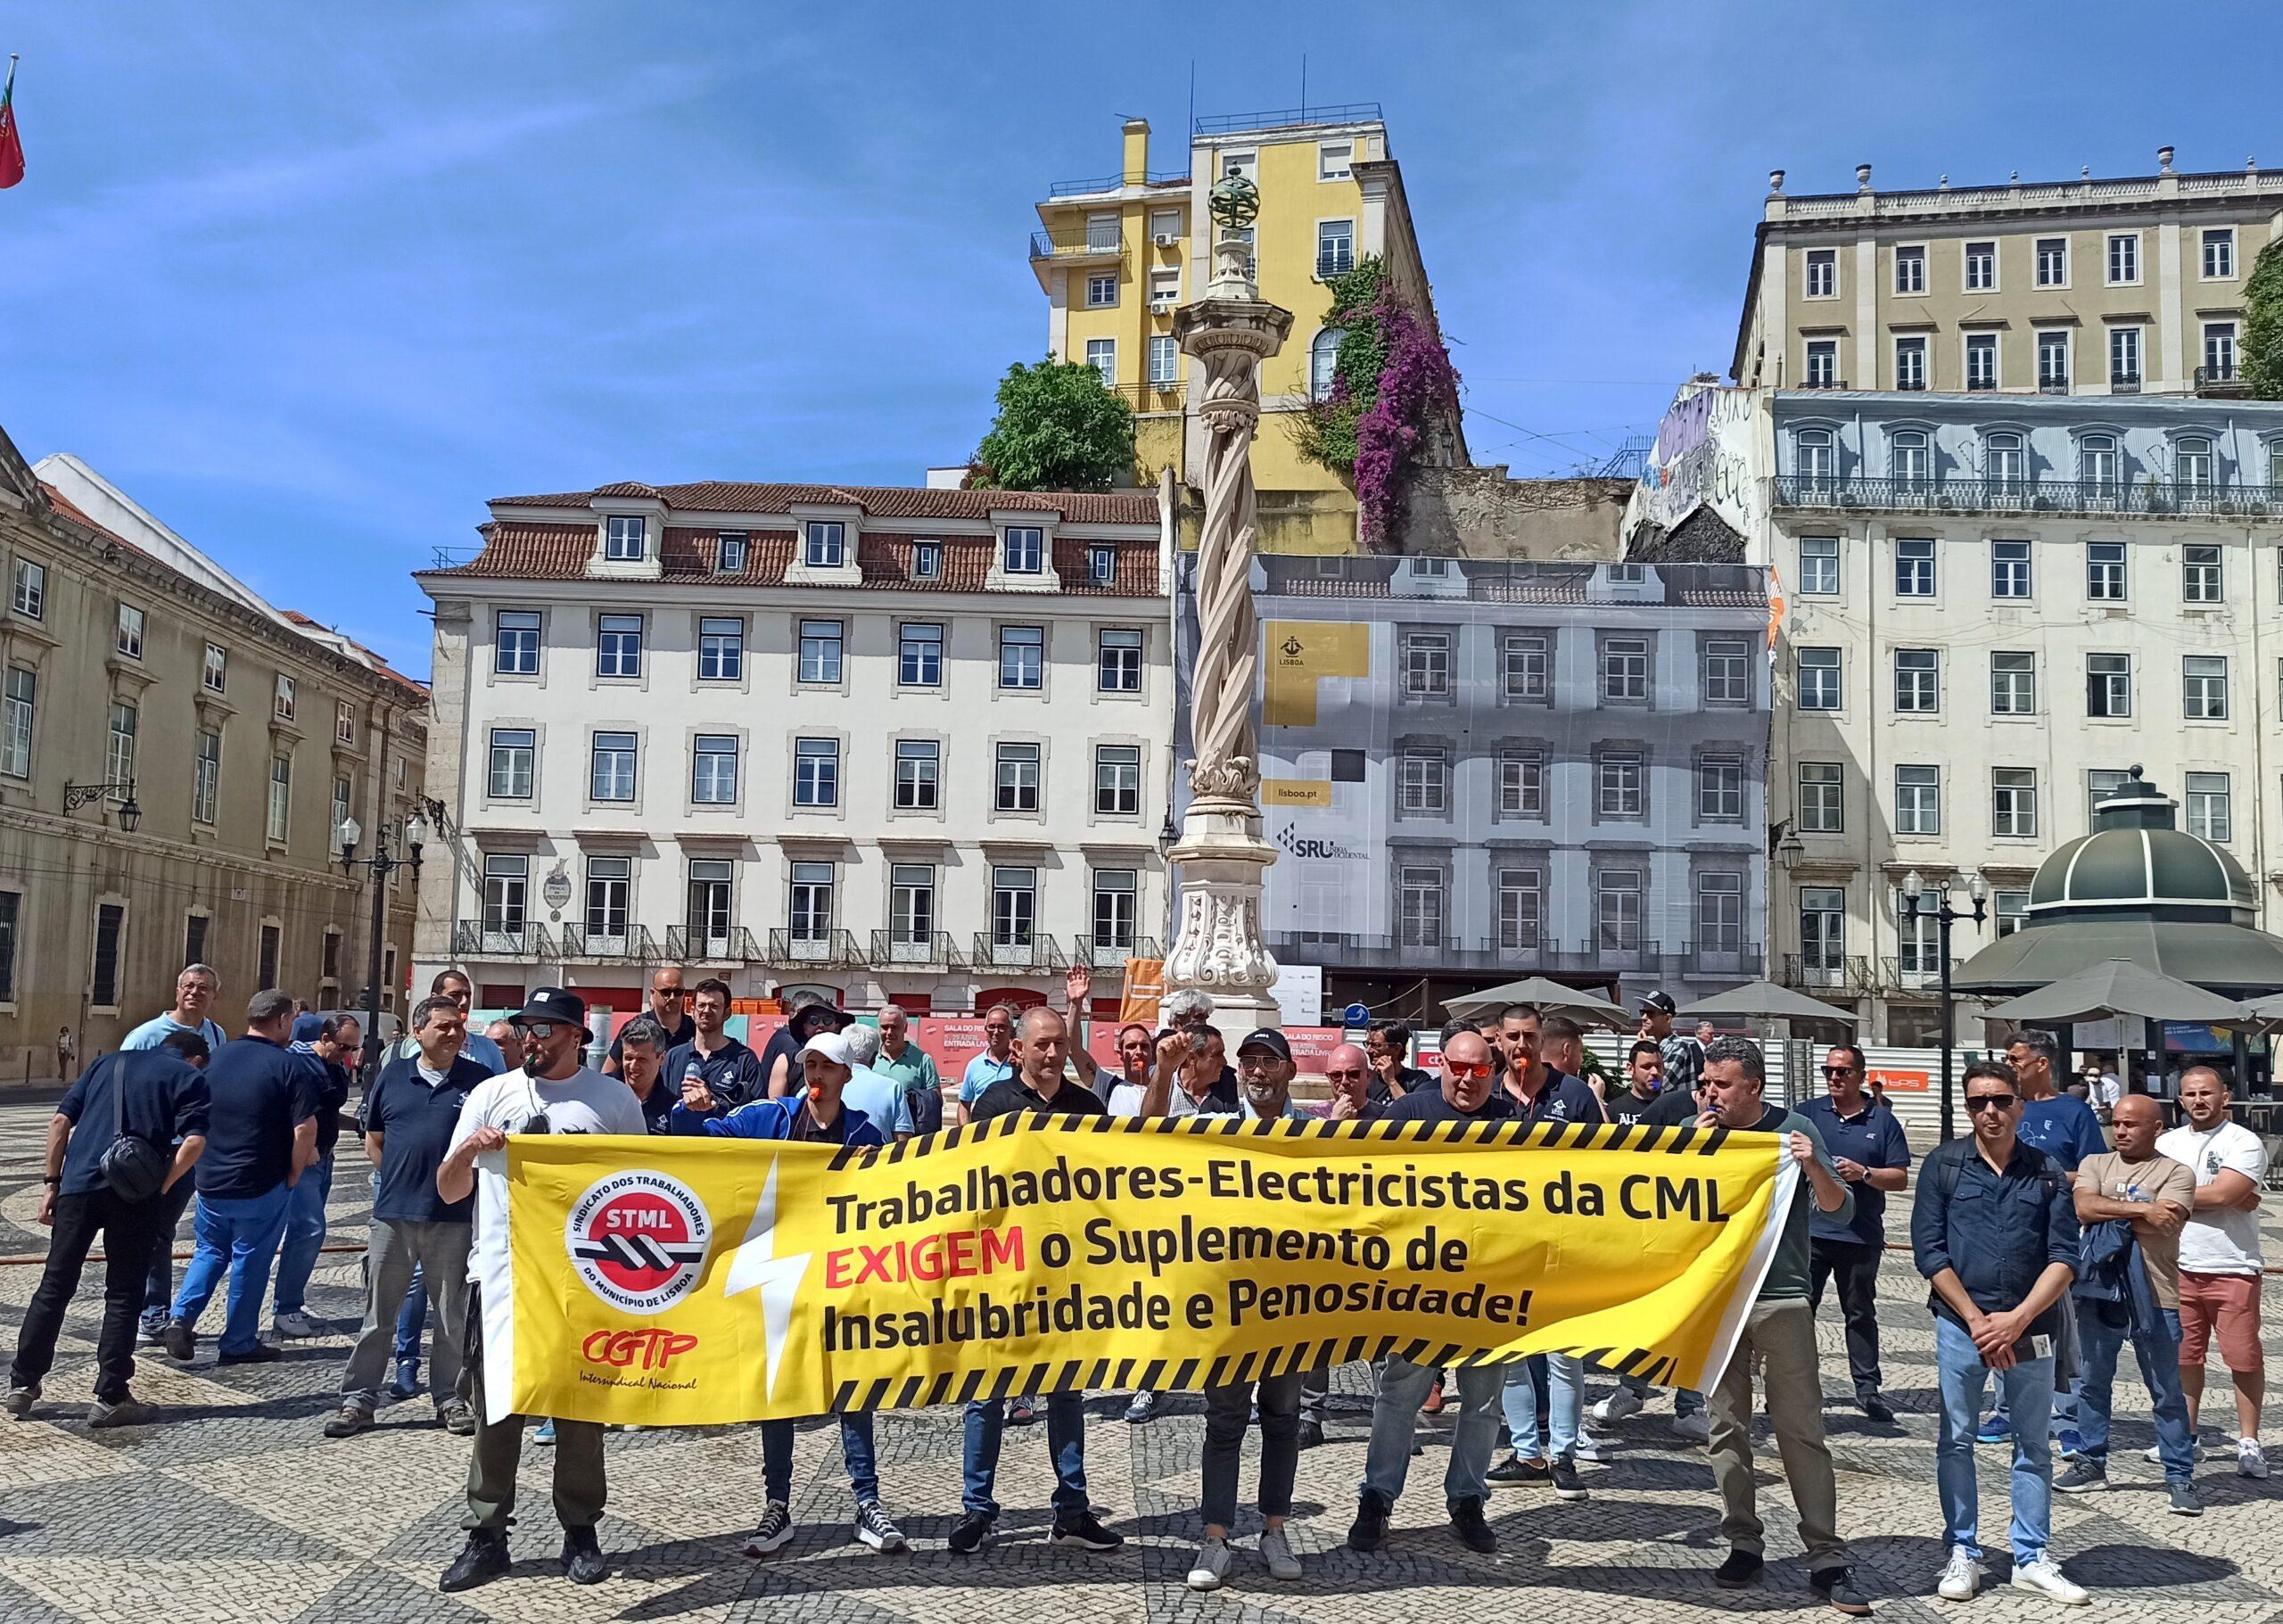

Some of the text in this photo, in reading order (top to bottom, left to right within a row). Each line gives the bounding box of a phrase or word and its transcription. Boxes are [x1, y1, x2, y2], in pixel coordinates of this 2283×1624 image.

[1279, 658, 1305, 666] LISBOA
[1278, 788, 1317, 799] lisboa.pt
[1296, 839, 1333, 858] SRU
[573, 1176, 705, 1236] SINDICATO DOS TRABALHADORES
[826, 1156, 1731, 1234] Trabalhadores-Electricistas da CML
[606, 1208, 672, 1229] STML
[825, 1215, 1468, 1289] EXIGEM o Suplemento de
[583, 1266, 694, 1308] DO MUNICÍPIO DE LISBOA
[824, 1277, 1534, 1352] Insalubridade e Penosidade!
[582, 1328, 698, 1370] CGTP
[579, 1370, 697, 1389] Intersindical Nacional
